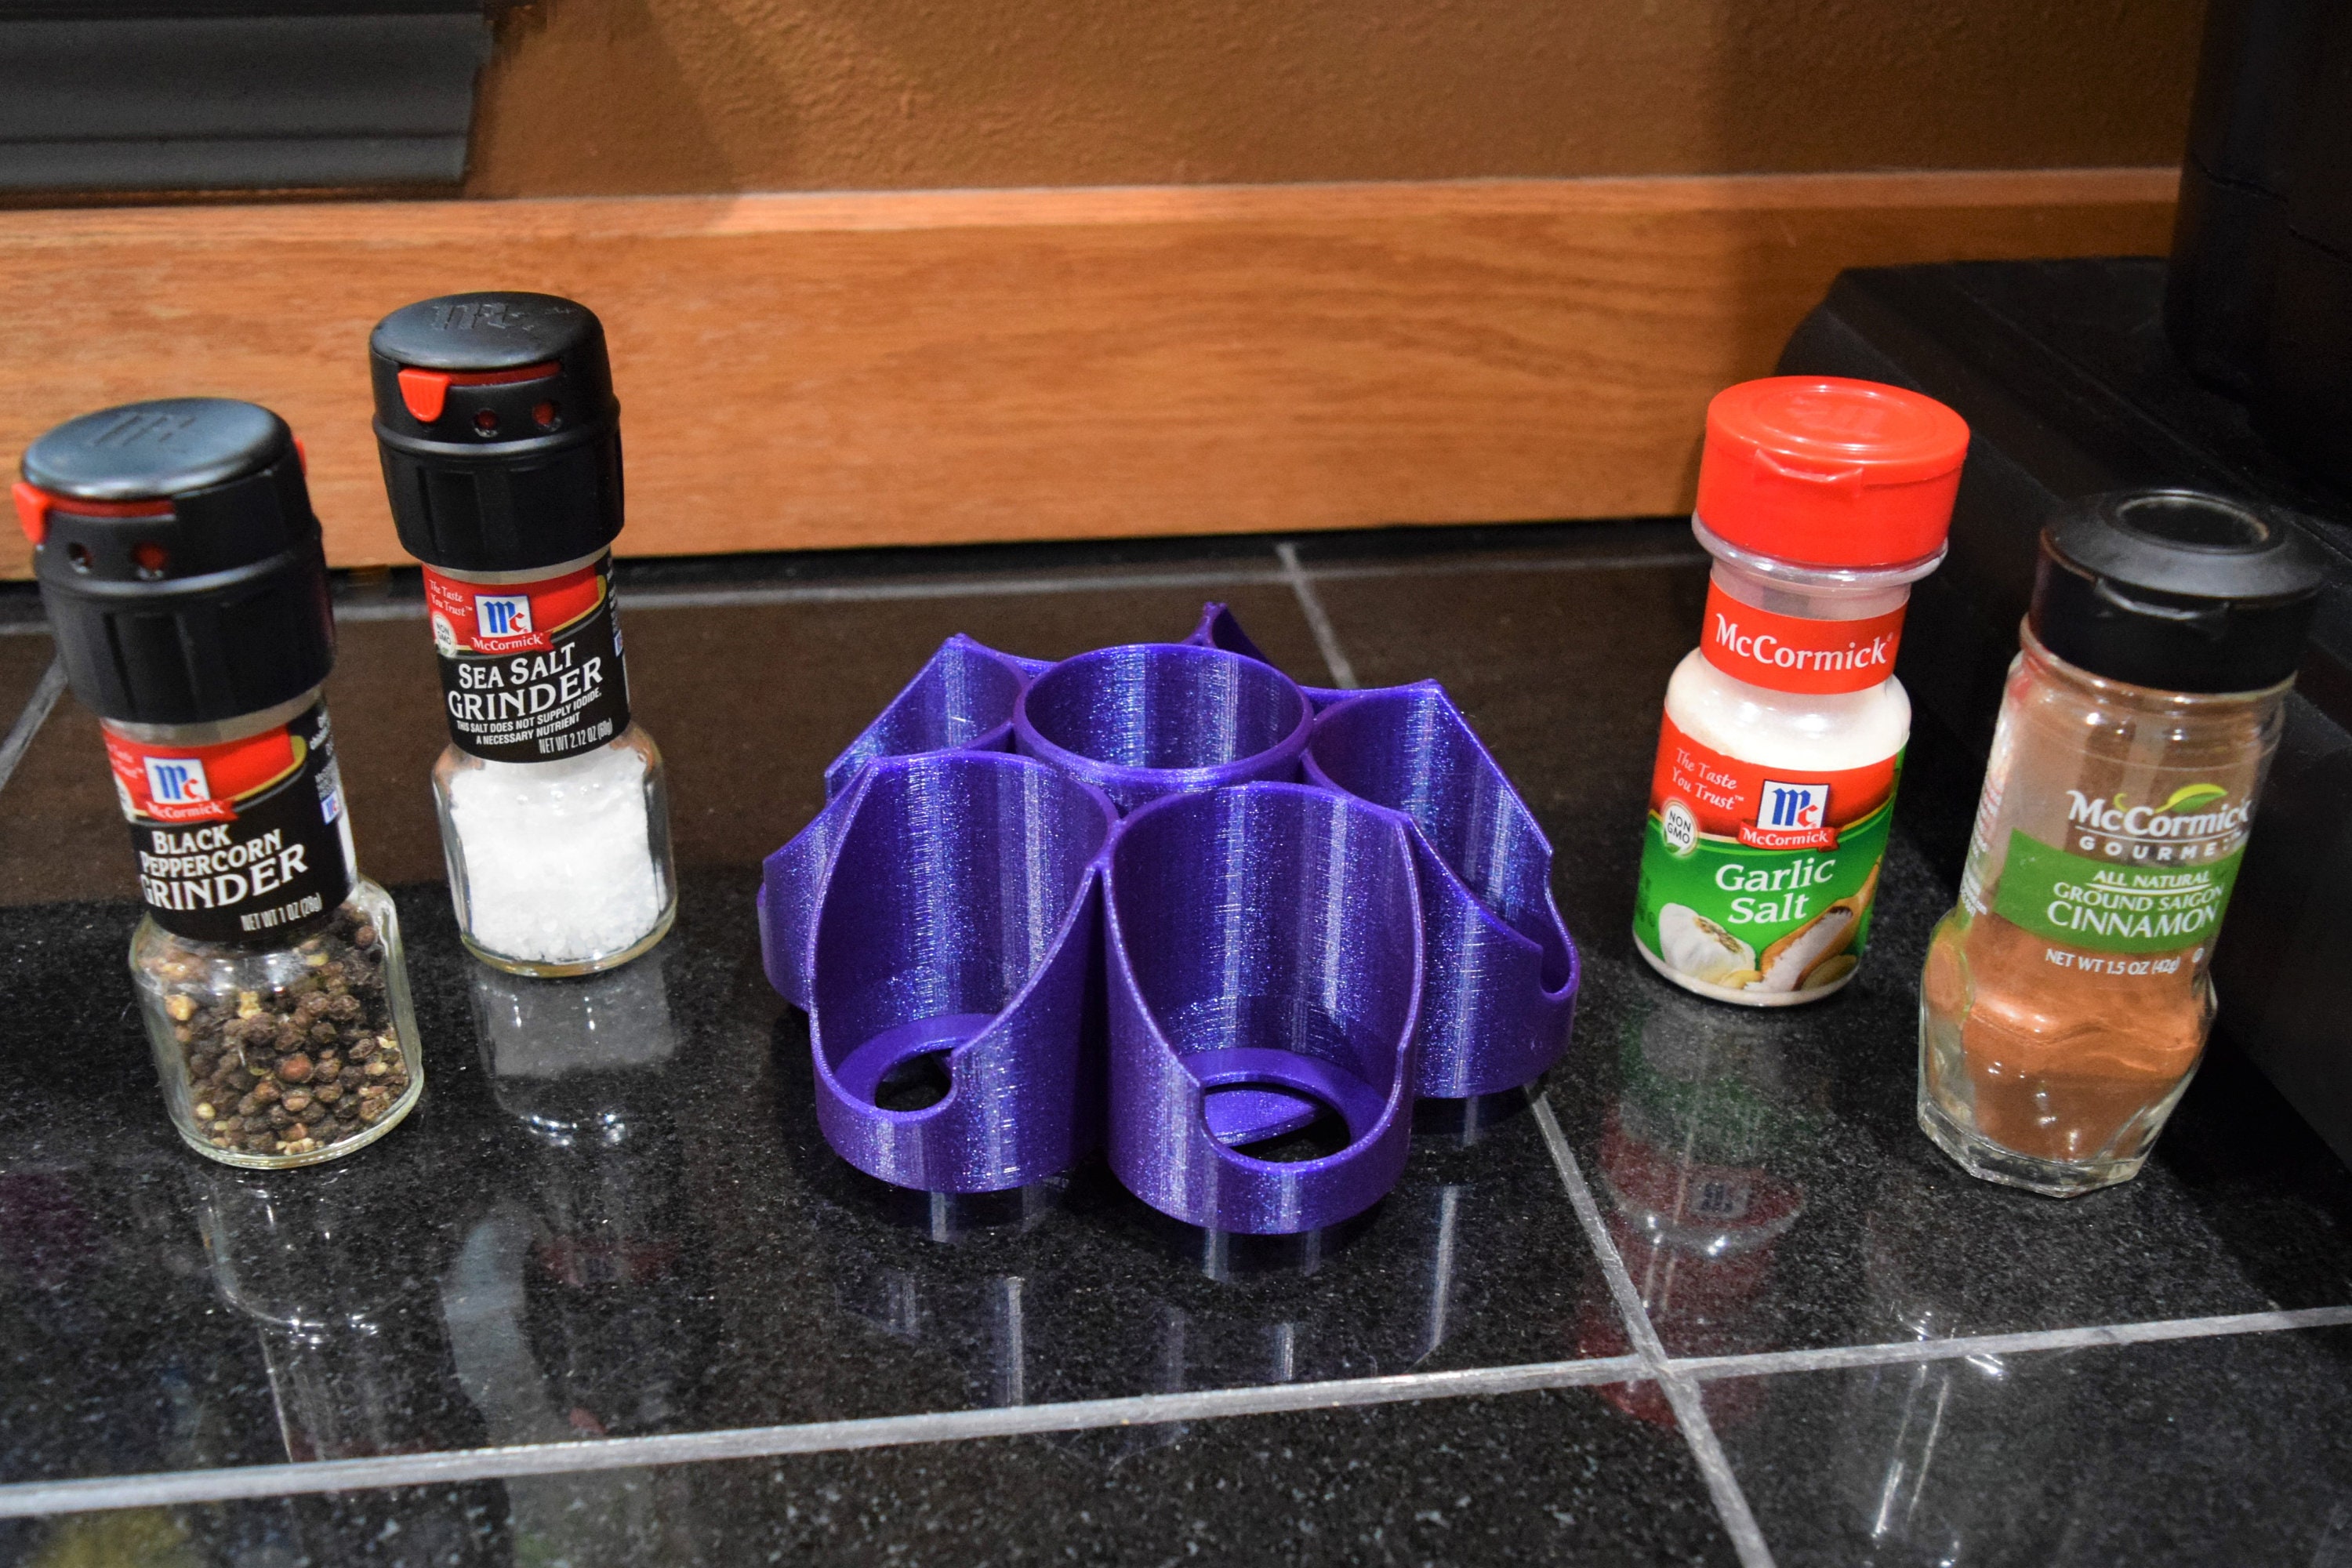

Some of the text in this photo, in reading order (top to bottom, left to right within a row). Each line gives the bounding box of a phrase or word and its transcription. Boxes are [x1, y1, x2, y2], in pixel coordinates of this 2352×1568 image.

[429, 579, 463, 602] The Taste
[430, 593, 444, 608] You
[459, 642, 575, 689] SEA SALT
[448, 656, 603, 720] GRINDER
[457, 720, 470, 732] THIS
[470, 723, 488, 733] SALT
[490, 720, 514, 733] DOES
[516, 717, 535, 730] NOT
[537, 703, 572, 725] SUPPLY
[476, 712, 580, 745] A NECESSARY NUTRIENT
[539, 737, 554, 753] NET
[555, 735, 568, 751] WT
[569, 729, 587, 749] 2.12
[587, 725, 597, 742] OZ
[1672, 767, 1691, 793] You
[1676, 747, 1737, 789] The Taste
[1669, 810, 1691, 833] NON
[2066, 789, 2252, 837] McCormick
[152, 824, 231, 855] BLACK
[1668, 822, 1690, 844] GMO
[140, 828, 282, 877] PEPPERCORN
[140, 844, 309, 910] GRINDER
[1715, 857, 1836, 892] Garlic
[2092, 870, 2210, 887] ALL NATURAL
[1727, 892, 1809, 924] Salt
[2053, 882, 2224, 912] GROUND SAIGON
[241, 913, 261, 931] NET
[261, 909, 278, 927] WT
[278, 907, 286, 923] 1
[286, 902, 301, 920] OZ
[2047, 900, 2220, 938] CINNAMON
[2045, 949, 2075, 967] NET
[2078, 956, 2104, 973] WT
[2107, 961, 2125, 975] 1.5
[2128, 961, 2150, 975] OZ
